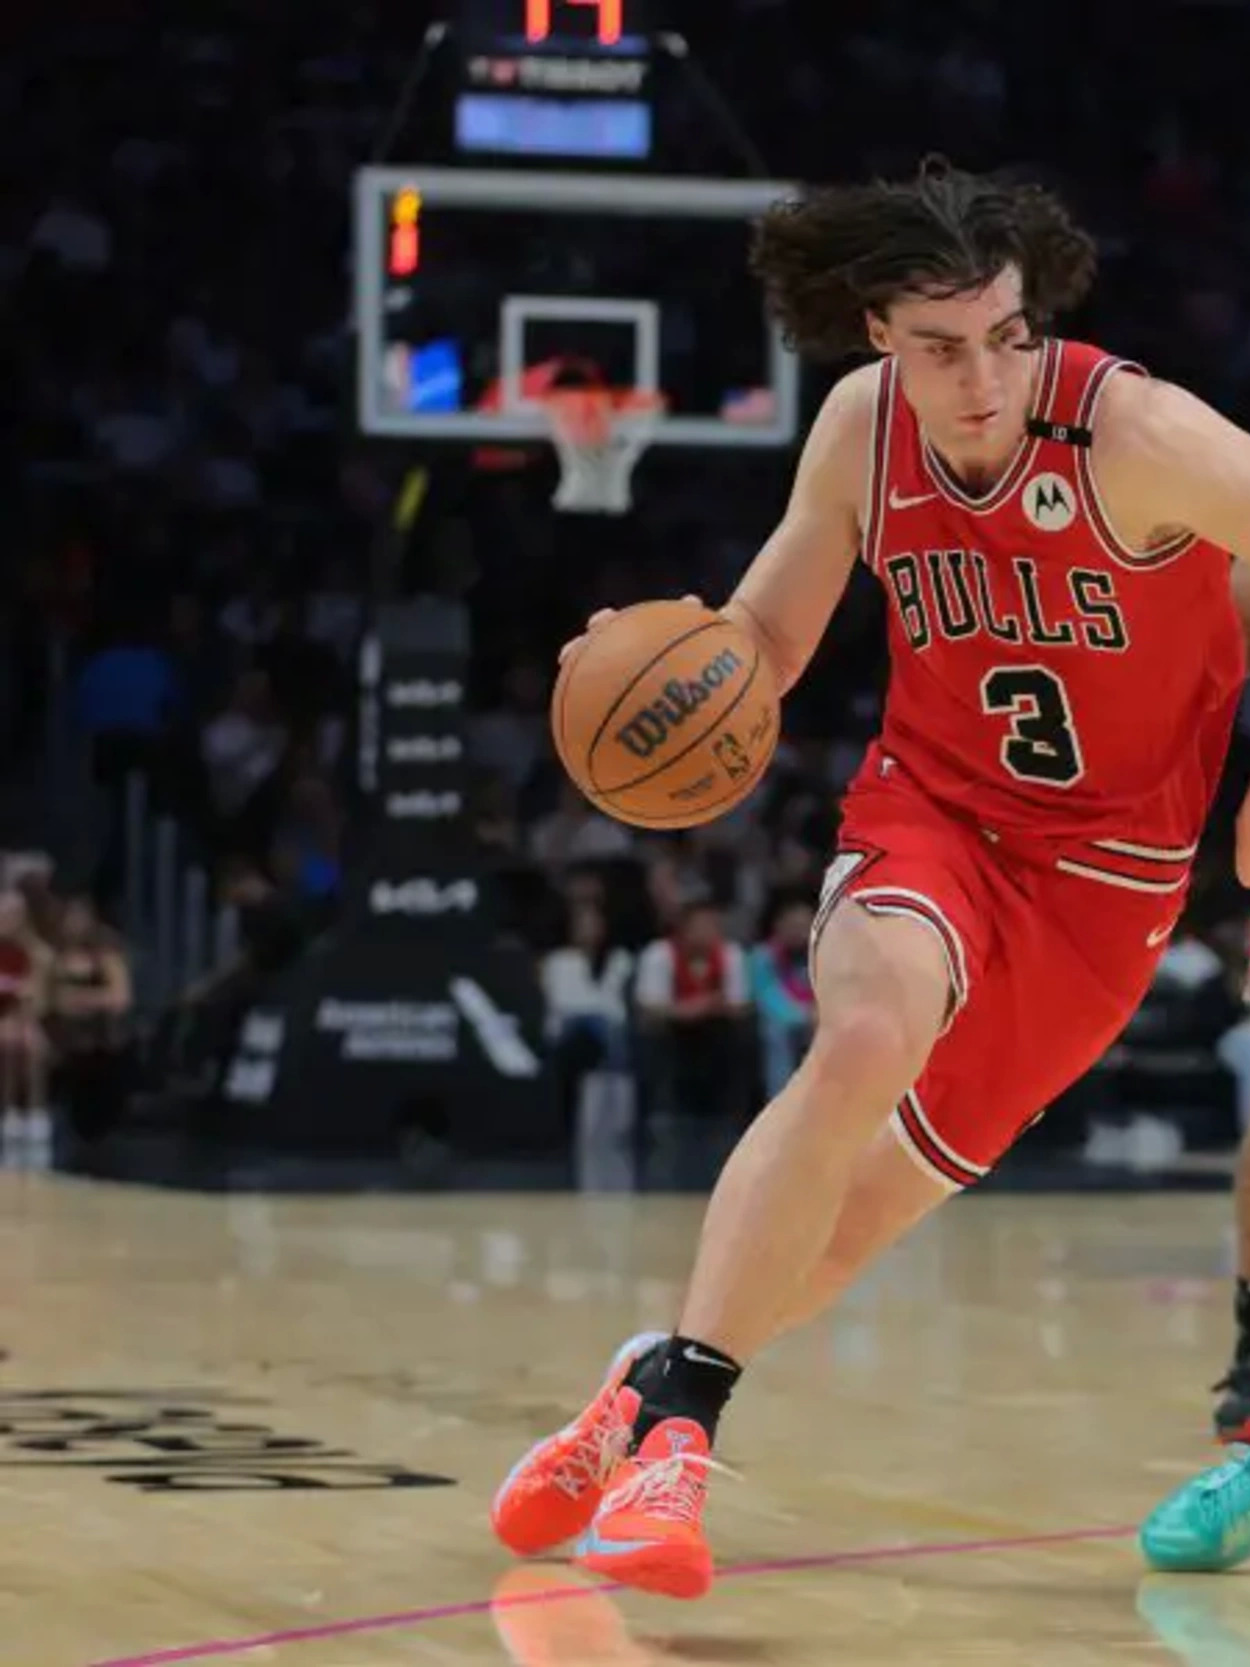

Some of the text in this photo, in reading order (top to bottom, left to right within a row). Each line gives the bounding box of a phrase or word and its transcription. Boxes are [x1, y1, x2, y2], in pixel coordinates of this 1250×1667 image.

[884, 549, 1131, 654] BULLS
[616, 647, 742, 759] Wilson
[979, 663, 1085, 789] 3
